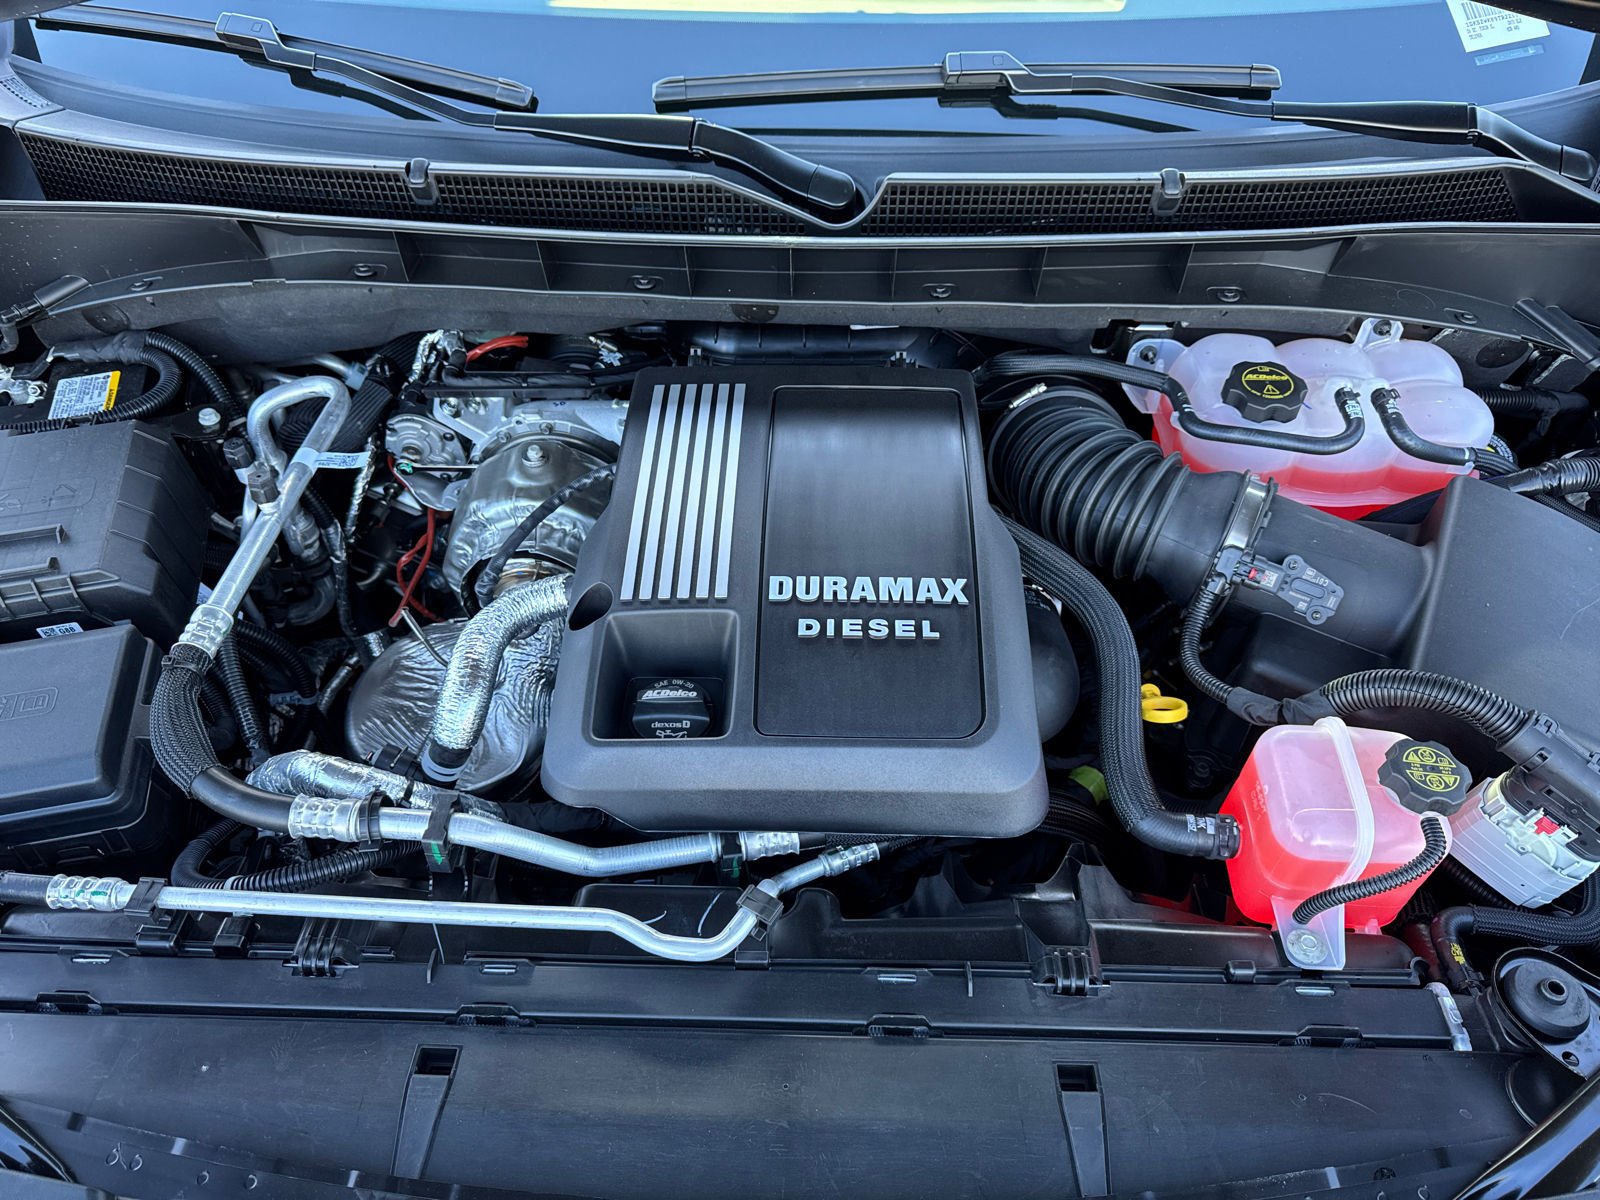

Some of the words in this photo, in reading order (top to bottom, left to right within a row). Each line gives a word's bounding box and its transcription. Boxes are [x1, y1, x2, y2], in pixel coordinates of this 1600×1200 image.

[1244, 373, 1289, 381] ACDelco
[768, 575, 969, 605] DURAMAX
[797, 618, 940, 639] DIESEL
[654, 680, 669, 689] SAE
[672, 679, 694, 689] 0W-20
[641, 689, 698, 699] ACDelco
